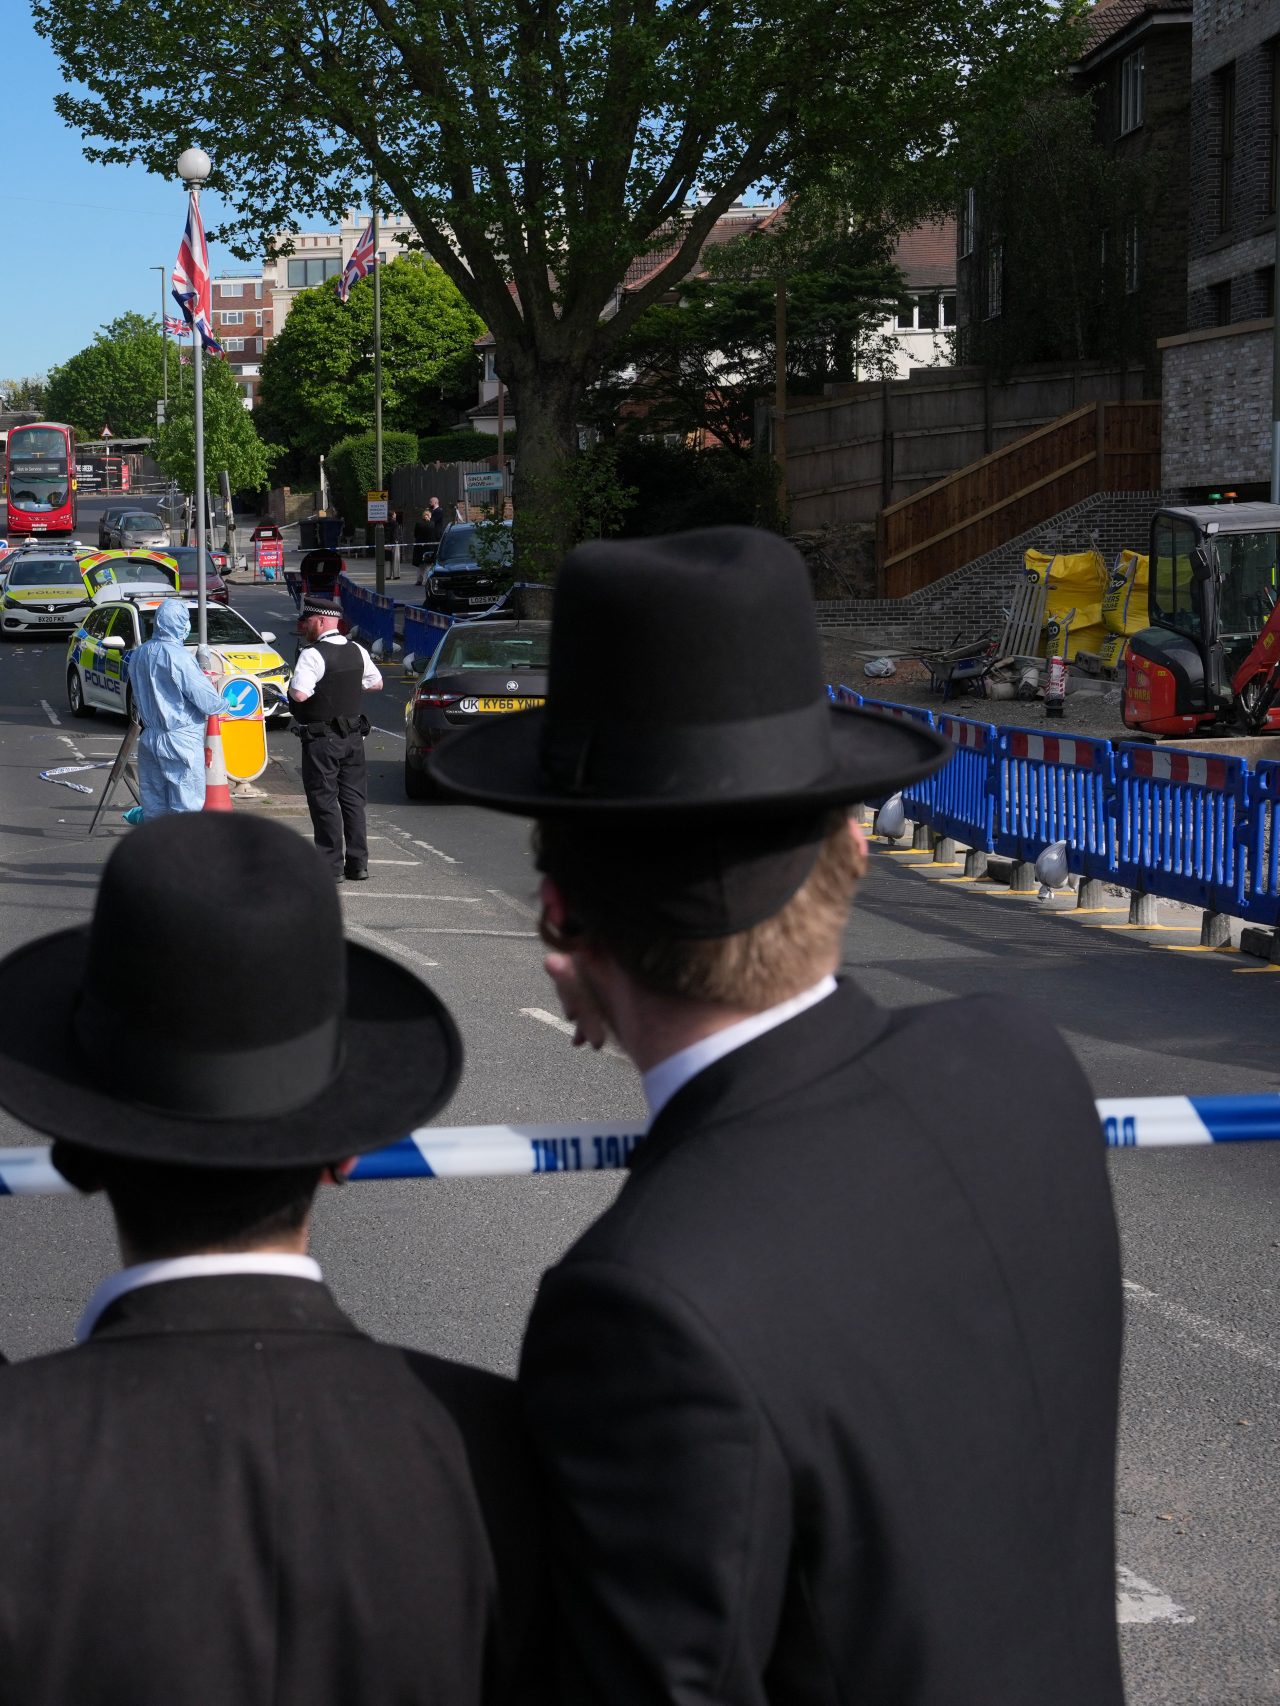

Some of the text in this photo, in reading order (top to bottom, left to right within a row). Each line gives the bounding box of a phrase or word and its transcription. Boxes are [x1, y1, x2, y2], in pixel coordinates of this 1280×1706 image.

[227, 653, 261, 661] ICE
[85, 669, 121, 695] POLICE
[462, 699, 478, 710] UK
[483, 698, 515, 709] KY66
